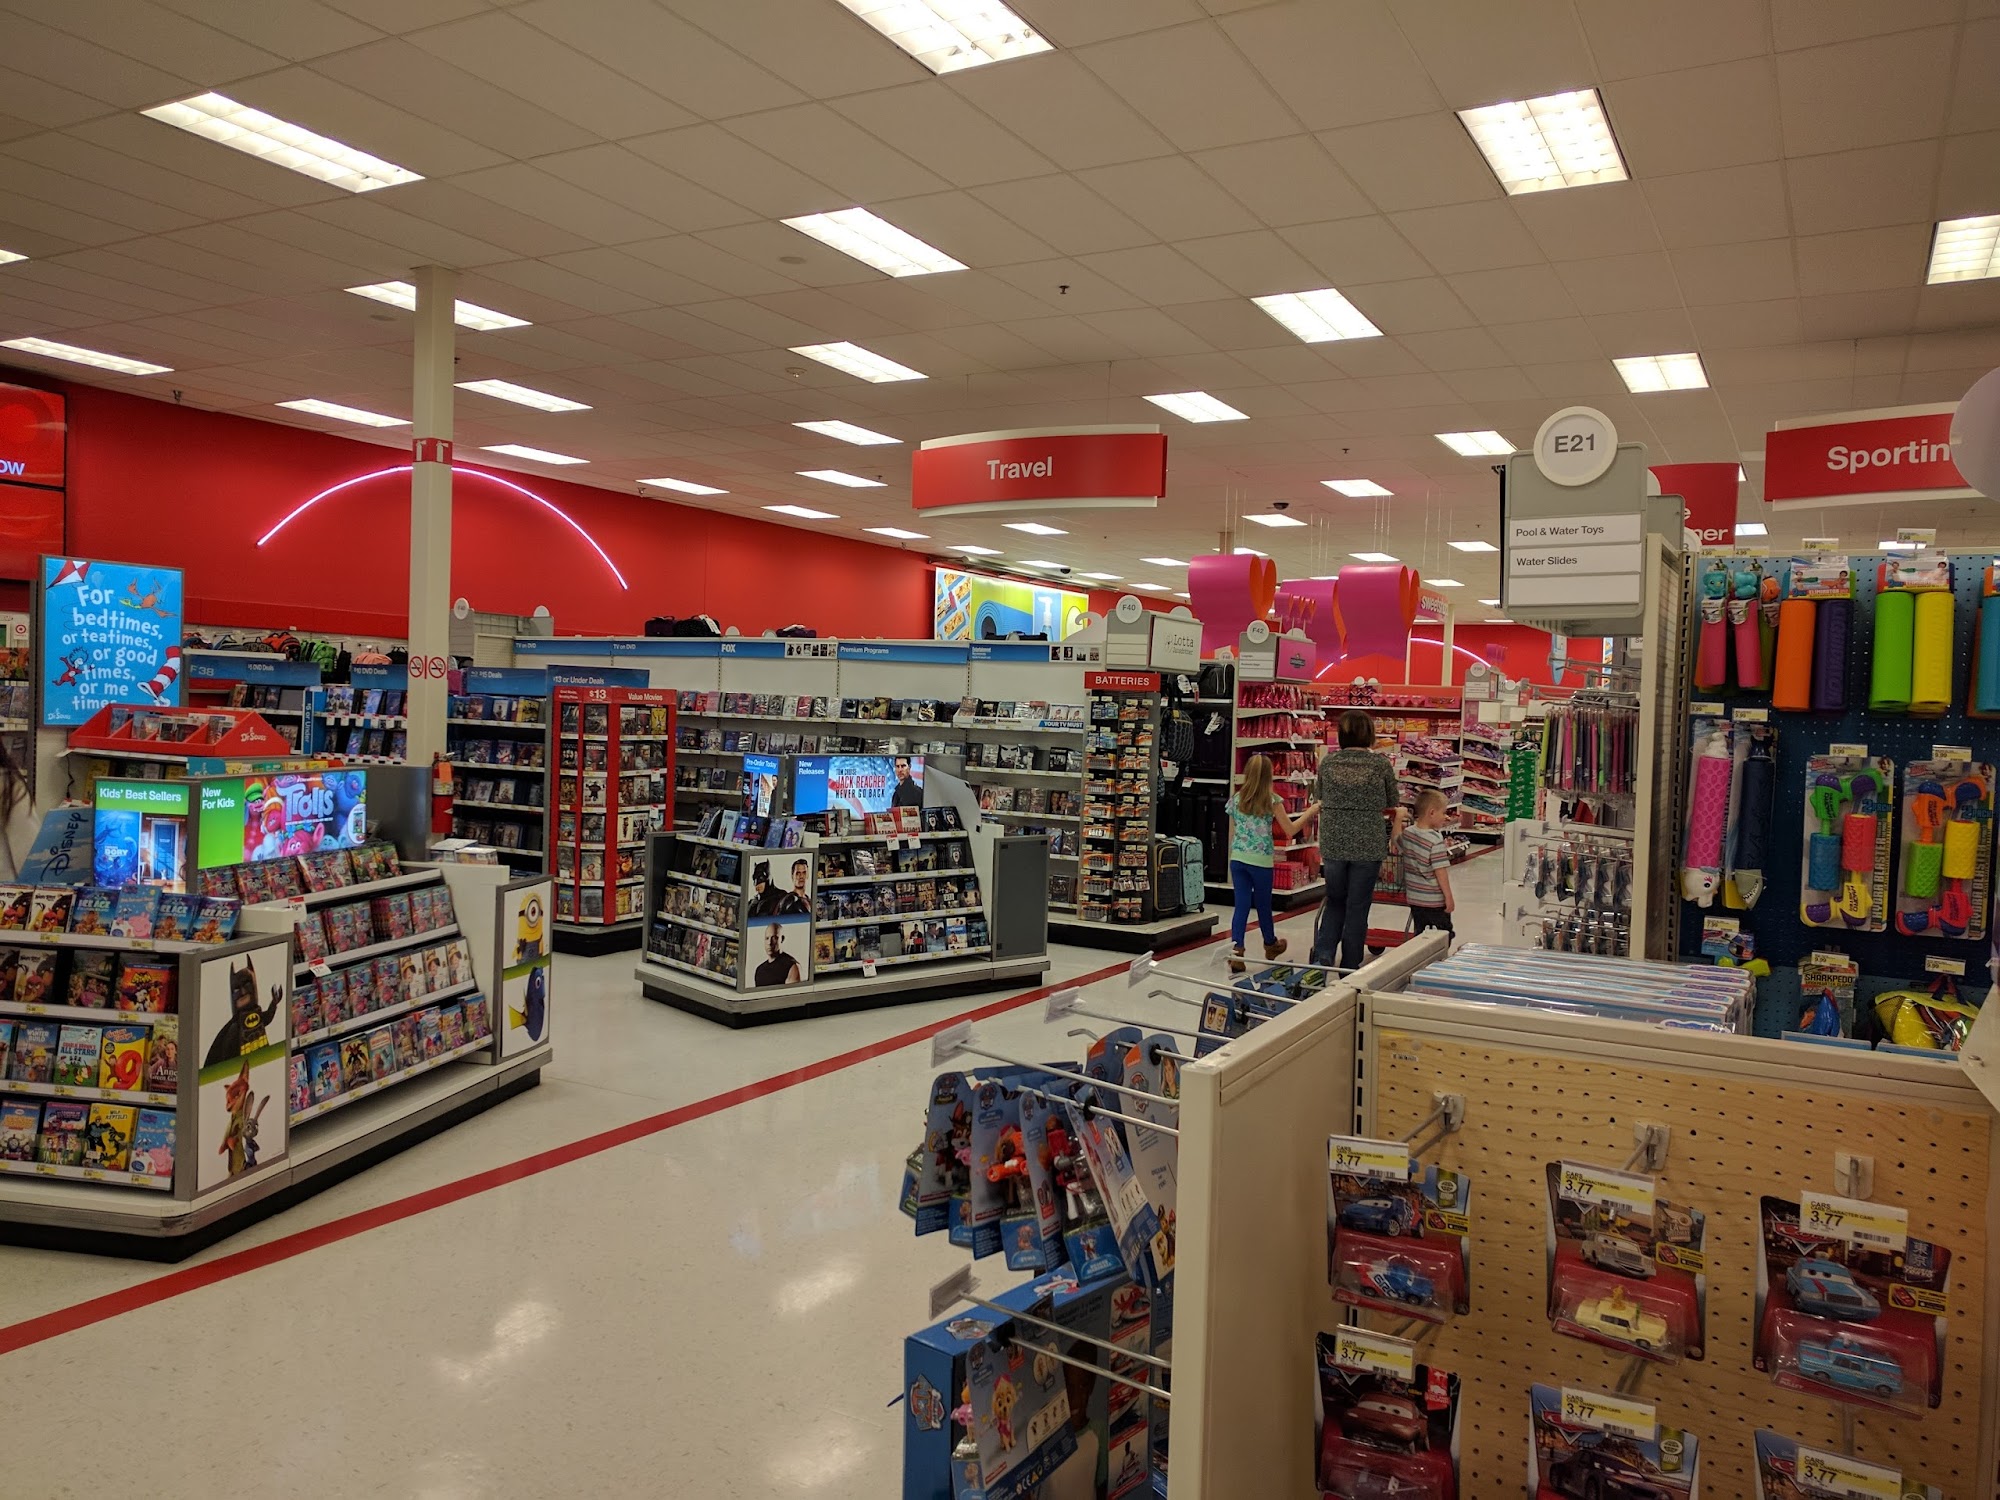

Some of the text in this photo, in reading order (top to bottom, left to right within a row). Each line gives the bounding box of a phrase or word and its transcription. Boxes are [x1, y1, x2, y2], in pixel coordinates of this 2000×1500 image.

[1555, 433, 1595, 453] E21
[1827, 438, 1951, 474] Sportin
[986, 456, 1053, 480] Travel
[1516, 524, 1604, 537] Pool & Water Toys
[1699, 528, 1729, 542] ner
[1516, 556, 1577, 566] Water Slides
[77, 585, 114, 607] For
[72, 607, 163, 641] bedtimes,
[62, 628, 152, 650] or teatimes,
[721, 643, 735, 653] FOX
[840, 646, 863, 654] Premium
[93, 647, 158, 667] or good
[82, 663, 136, 682] times,
[570, 676, 588, 684] Under
[1095, 675, 1150, 686] BATTERIES
[79, 682, 129, 696] or me
[589, 689, 607, 700] $13
[627, 692, 663, 701] Value Movies
[765, 761, 778, 769] Today
[799, 767, 825, 775] Releases
[835, 775, 885, 788] JACK REACHER
[125, 789, 147, 801] Best
[148, 790, 181, 802] Sellers
[202, 787, 221, 798] New
[835, 788, 885, 798] NEVER GO BACK
[202, 798, 235, 810] For Kids
[276, 783, 334, 821] Trolls
[1873, 838, 1886, 881] BLASTER
[1871, 880, 1884, 921] HYDRA
[1805, 973, 1853, 984] SHARKPEDO
[1336, 1154, 1361, 1166] 3.77
[1565, 1171, 1583, 1179] CARS
[1565, 1179, 1593, 1195] 3.77
[1810, 1200, 1831, 1209] CARS
[1810, 1210, 1843, 1227] 3.77
[1341, 1347, 1366, 1361] 3.77
[1566, 1393, 1583, 1402] CARS
[1566, 1403, 1594, 1418] 3.77
[1804, 1455, 1825, 1465] CARS
[1804, 1465, 1837, 1483] 3.77
